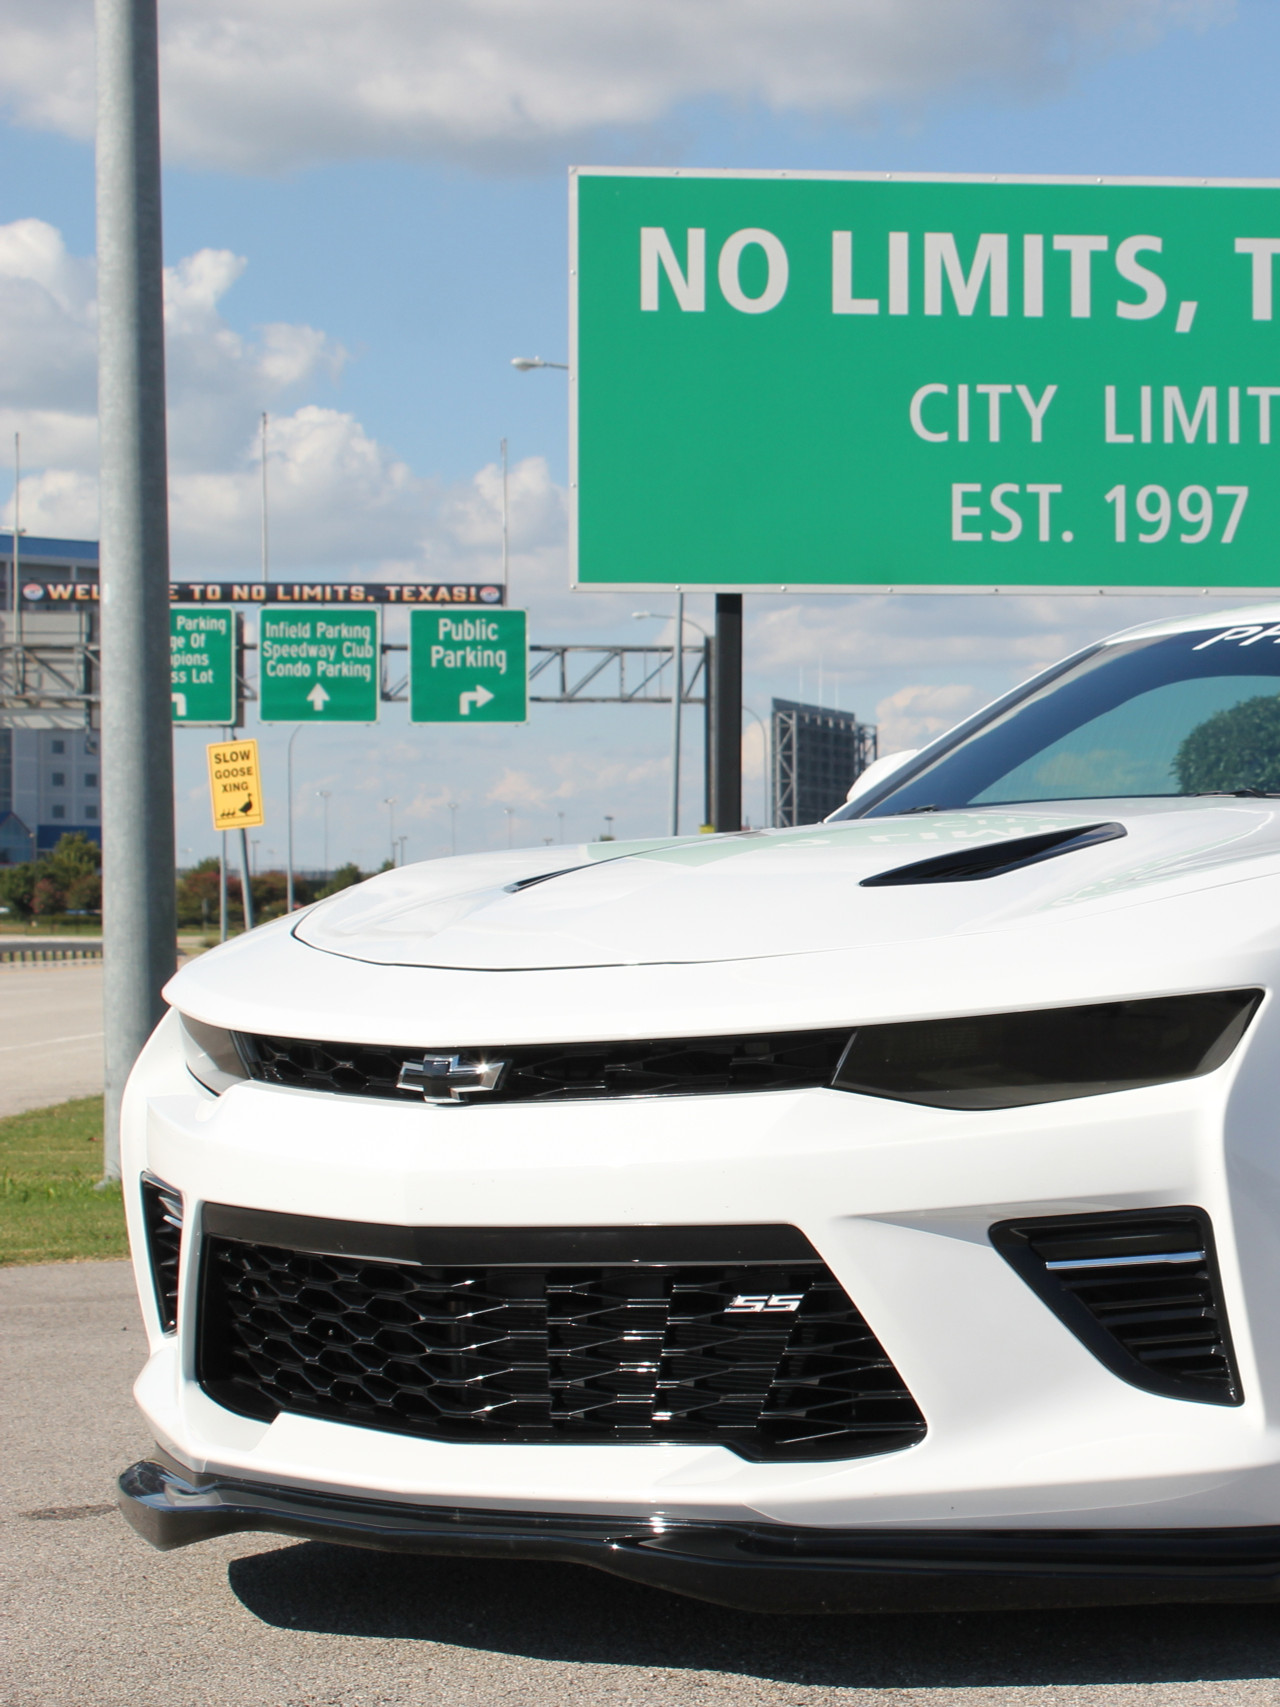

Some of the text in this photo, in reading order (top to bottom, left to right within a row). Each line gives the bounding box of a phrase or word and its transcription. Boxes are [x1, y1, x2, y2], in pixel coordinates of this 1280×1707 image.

[640, 227, 790, 315] NO
[831, 230, 1198, 333] LIMITS,
[909, 383, 1058, 443] CITY
[951, 483, 1249, 544] EST. 1997
[188, 584, 221, 600] TO
[232, 584, 266, 601] NO
[277, 585, 375, 602] LIMITS,
[385, 585, 477, 602] TEXAS!
[176, 615, 226, 636] Parking
[265, 621, 371, 642] Infield Parking
[438, 618, 498, 641] Public
[190, 632, 206, 649] Of
[263, 641, 374, 661] Speedway Club
[430, 645, 507, 675] Parking
[191, 668, 213, 684] Lot
[266, 660, 371, 682] Condo Parking
[214, 750, 250, 764] SLOW
[215, 767, 253, 780] GOOSE
[221, 781, 249, 793] XING
[723, 1294, 805, 1313] SS
